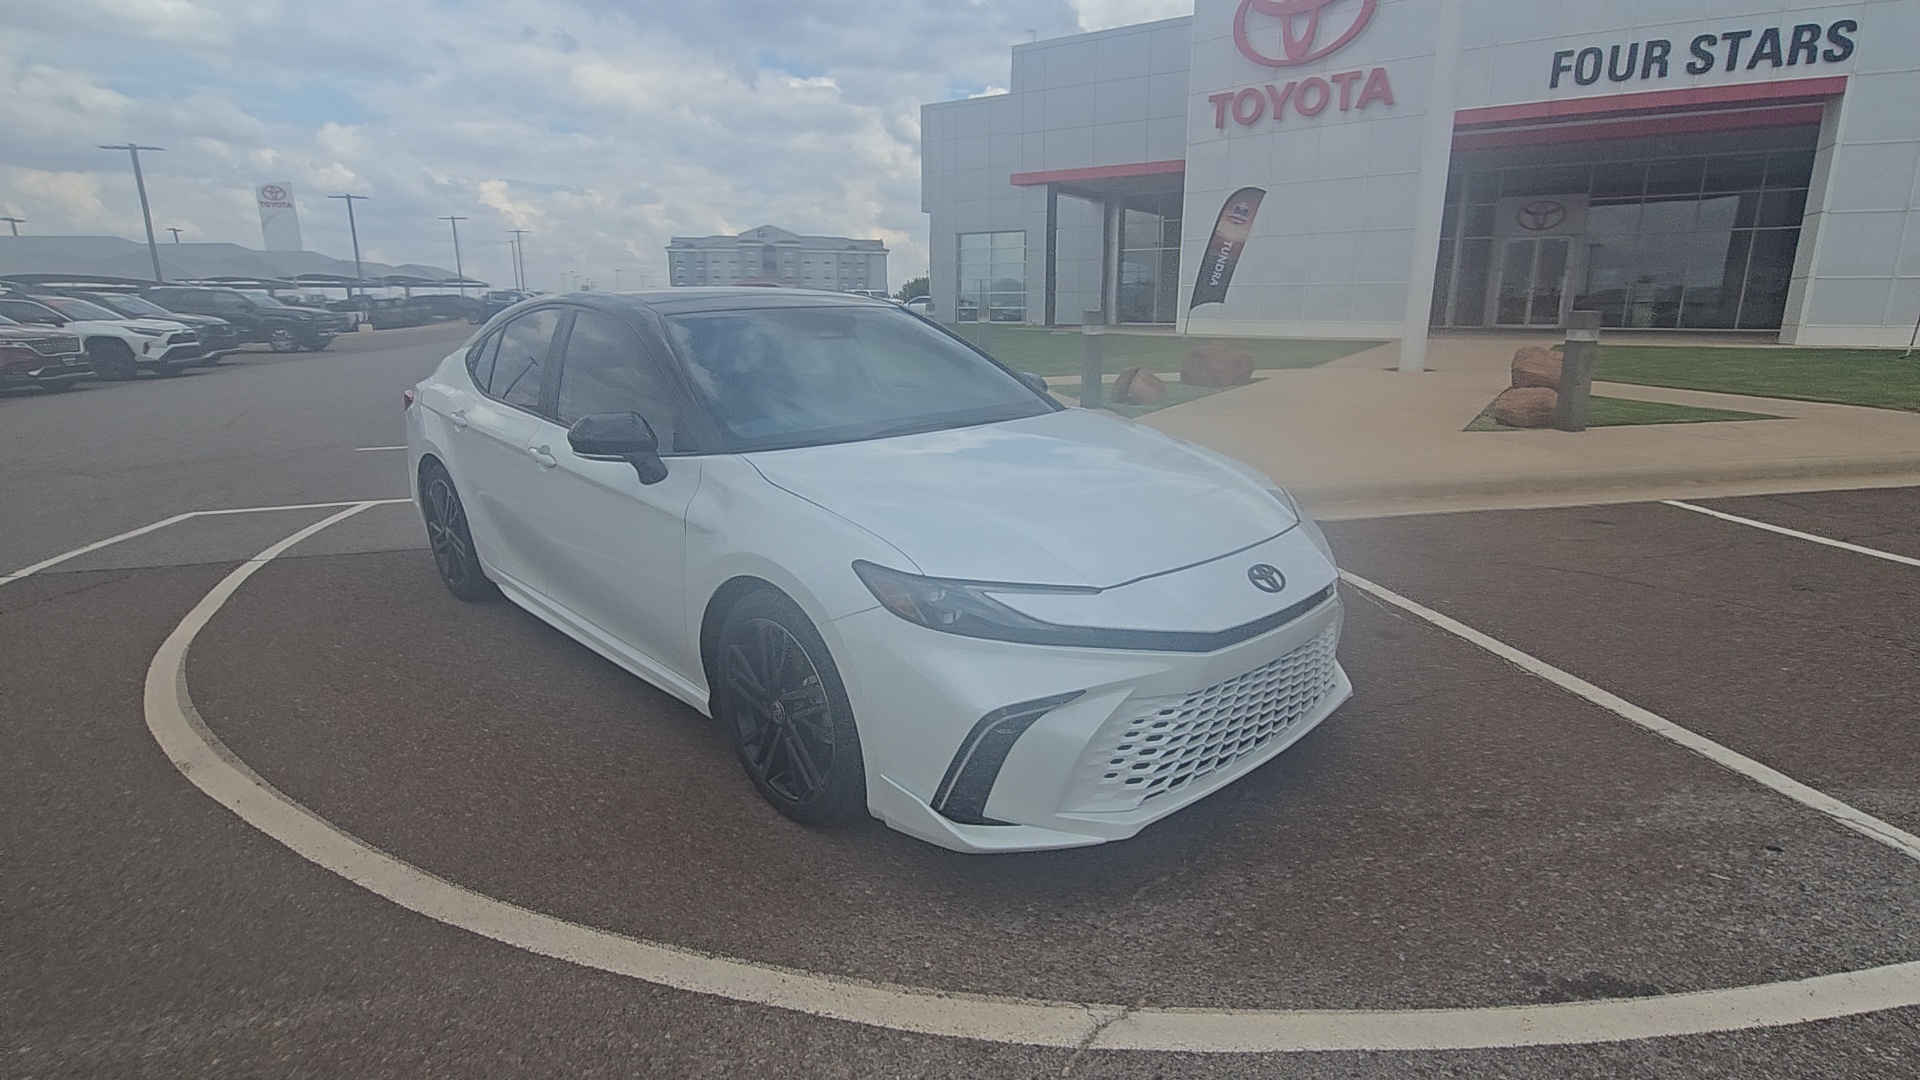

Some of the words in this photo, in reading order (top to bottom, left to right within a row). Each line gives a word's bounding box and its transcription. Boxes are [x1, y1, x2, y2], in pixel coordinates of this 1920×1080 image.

[1549, 38, 1672, 88] FOUR
[1685, 19, 1858, 75] STARS
[1208, 67, 1395, 129] TOYOTA
[259, 201, 293, 209] TOYOTA
[1209, 241, 1233, 286] TUNDRA
